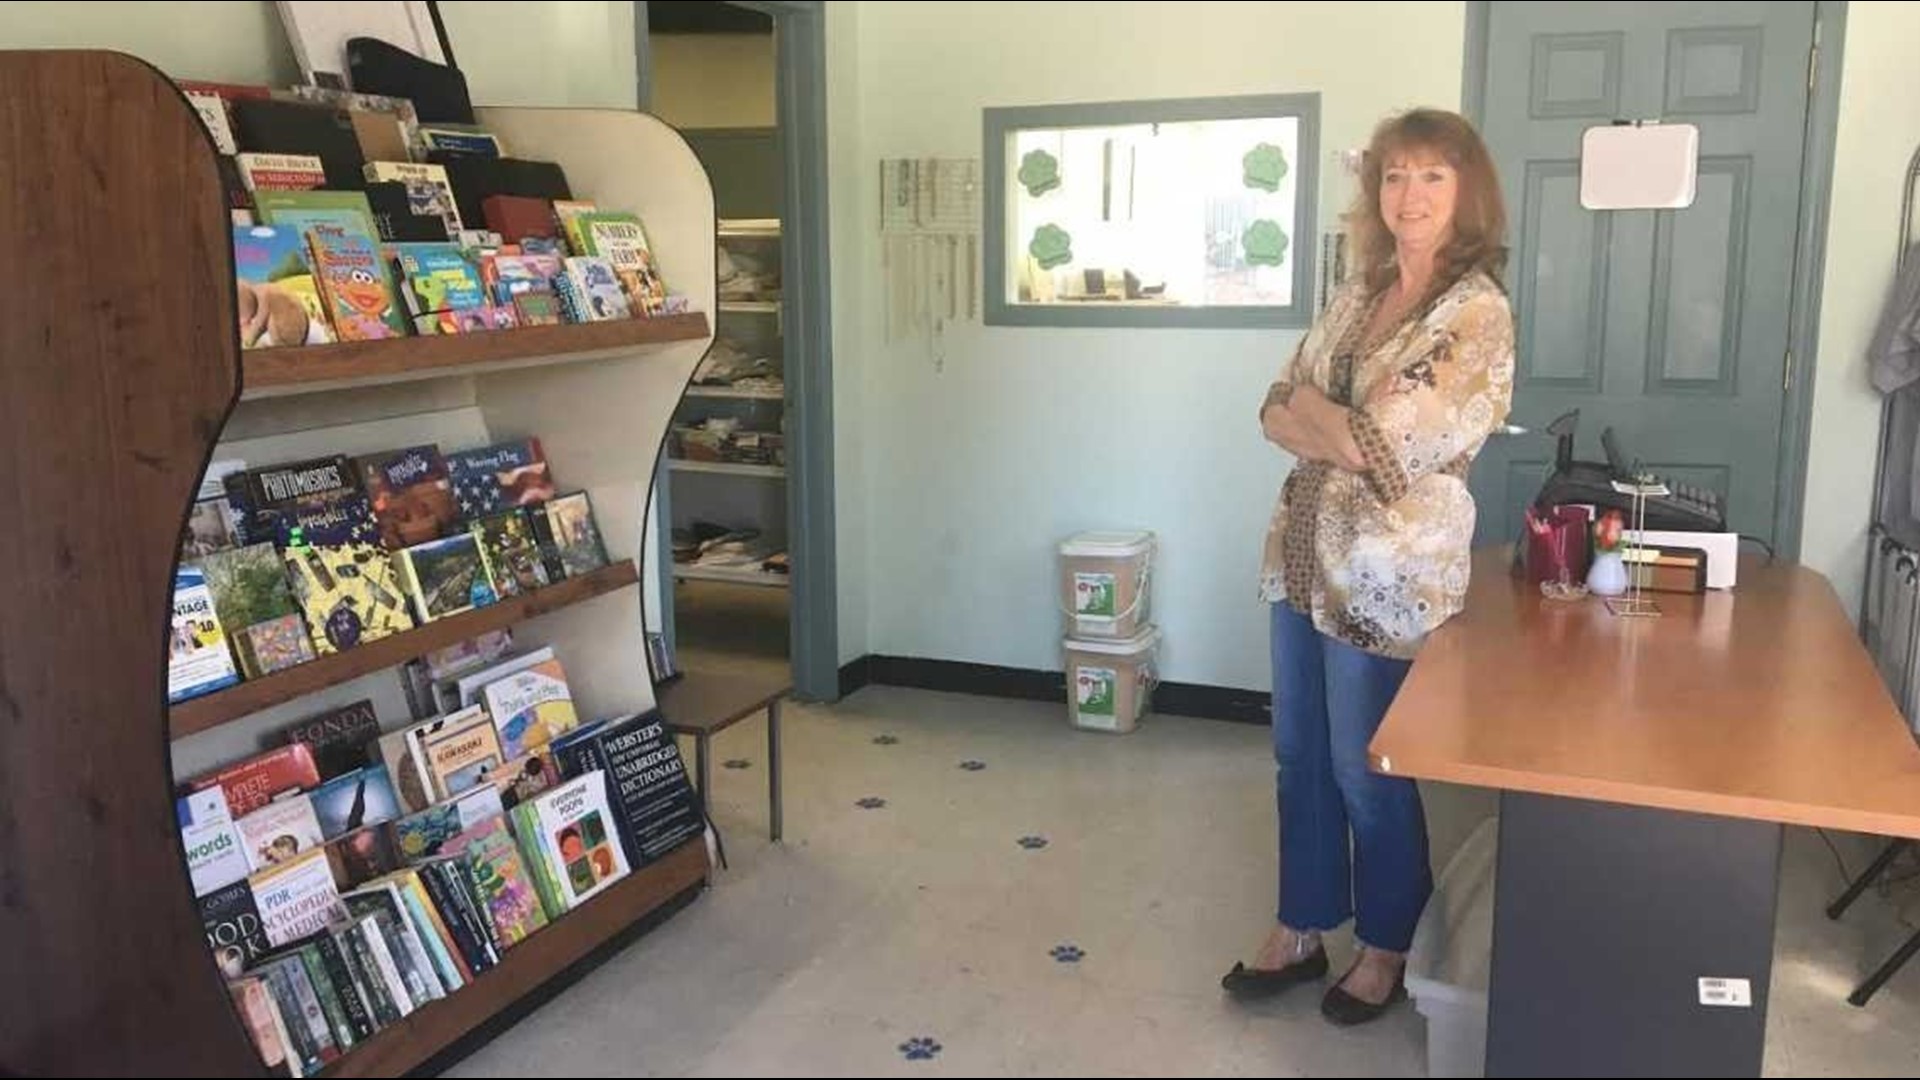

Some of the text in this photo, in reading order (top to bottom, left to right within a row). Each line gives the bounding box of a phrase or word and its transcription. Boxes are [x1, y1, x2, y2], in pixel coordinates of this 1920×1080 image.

[260, 465, 342, 501] PHOTOMOSAICS
[175, 600, 209, 616] NTAGE
[200, 620, 214, 633] 10
[293, 708, 374, 742] FONDA
[615, 746, 678, 778] UNABRIDGED
[621, 760, 681, 795] DICTIONARY
[226, 773, 271, 802] MPLETE
[263, 887, 340, 931] NCYCLOPEDIA
[265, 889, 293, 910] PDR
[207, 914, 258, 947] OD
